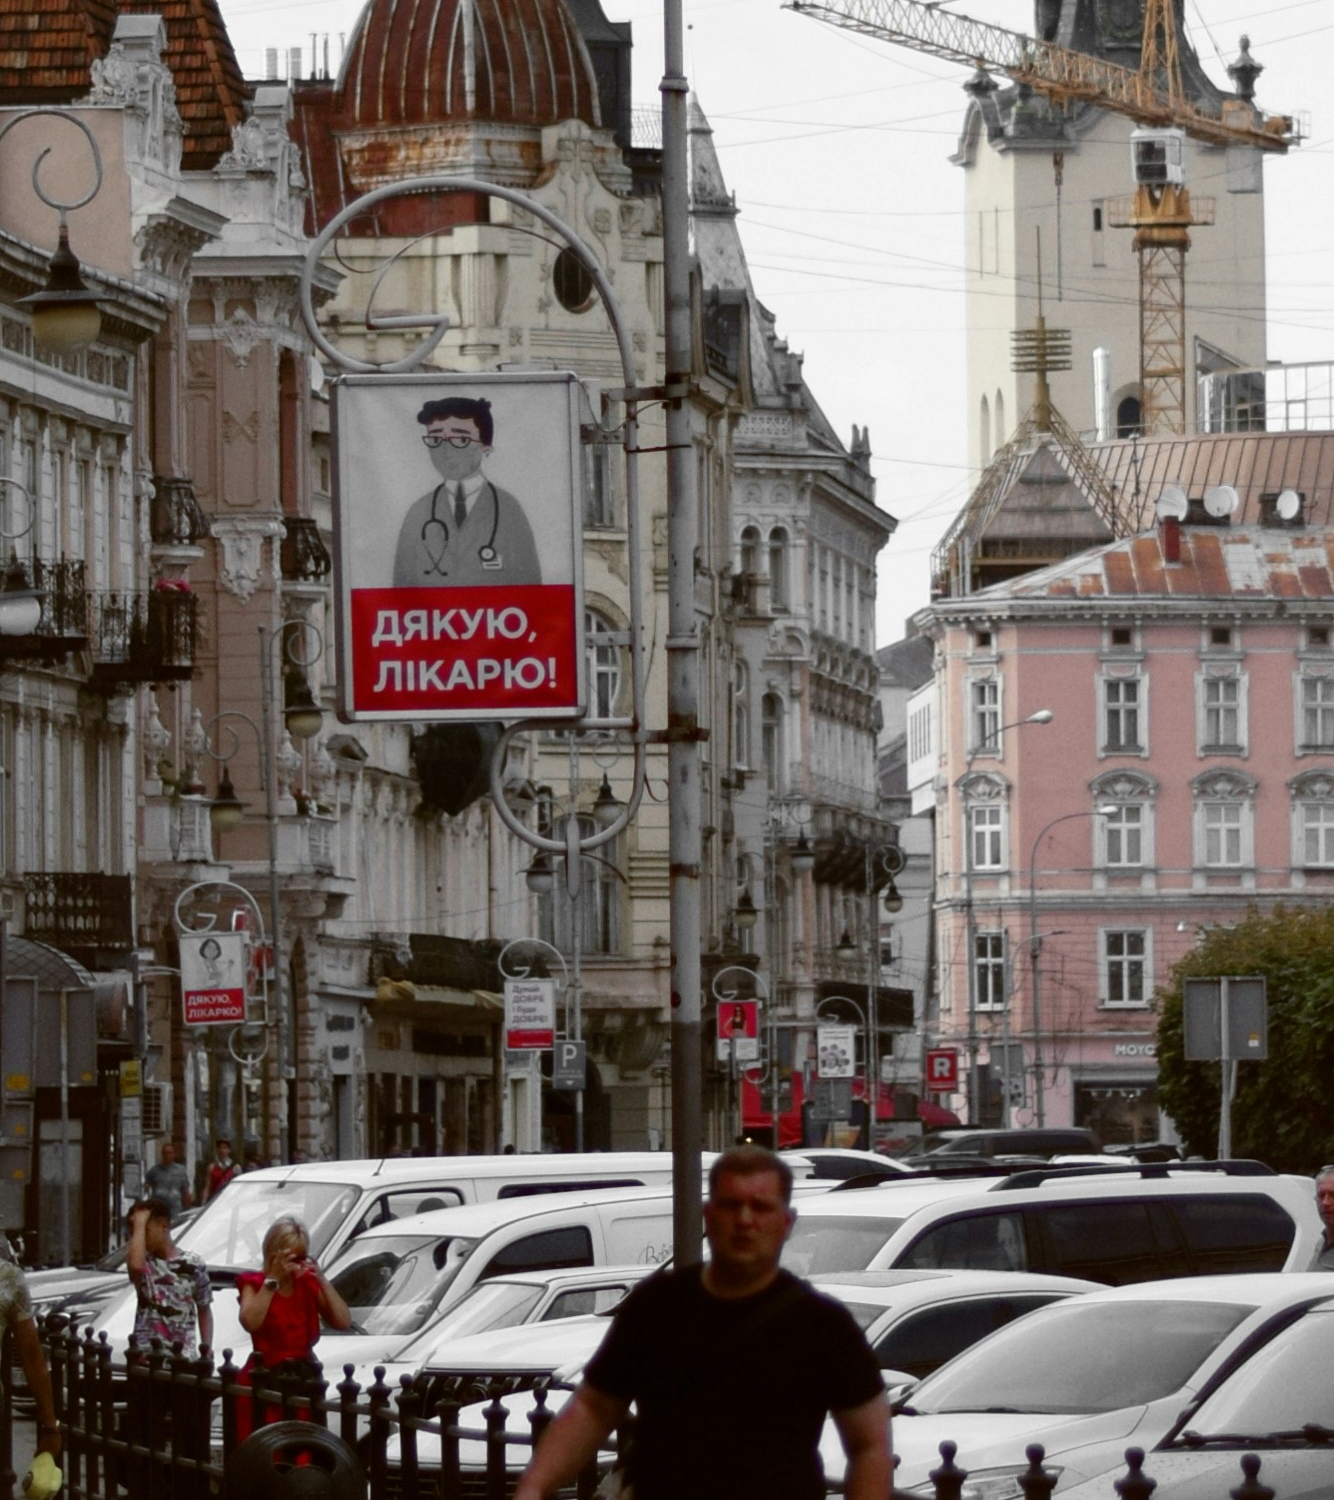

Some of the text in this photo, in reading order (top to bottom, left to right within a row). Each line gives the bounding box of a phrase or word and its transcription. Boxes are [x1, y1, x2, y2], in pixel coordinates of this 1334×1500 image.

[372, 606, 538, 648] ДЯКУЮ,
[373, 657, 557, 694] ЛІКАРЮ!
[562, 1044, 577, 1068] P
[933, 1057, 950, 1078] R
